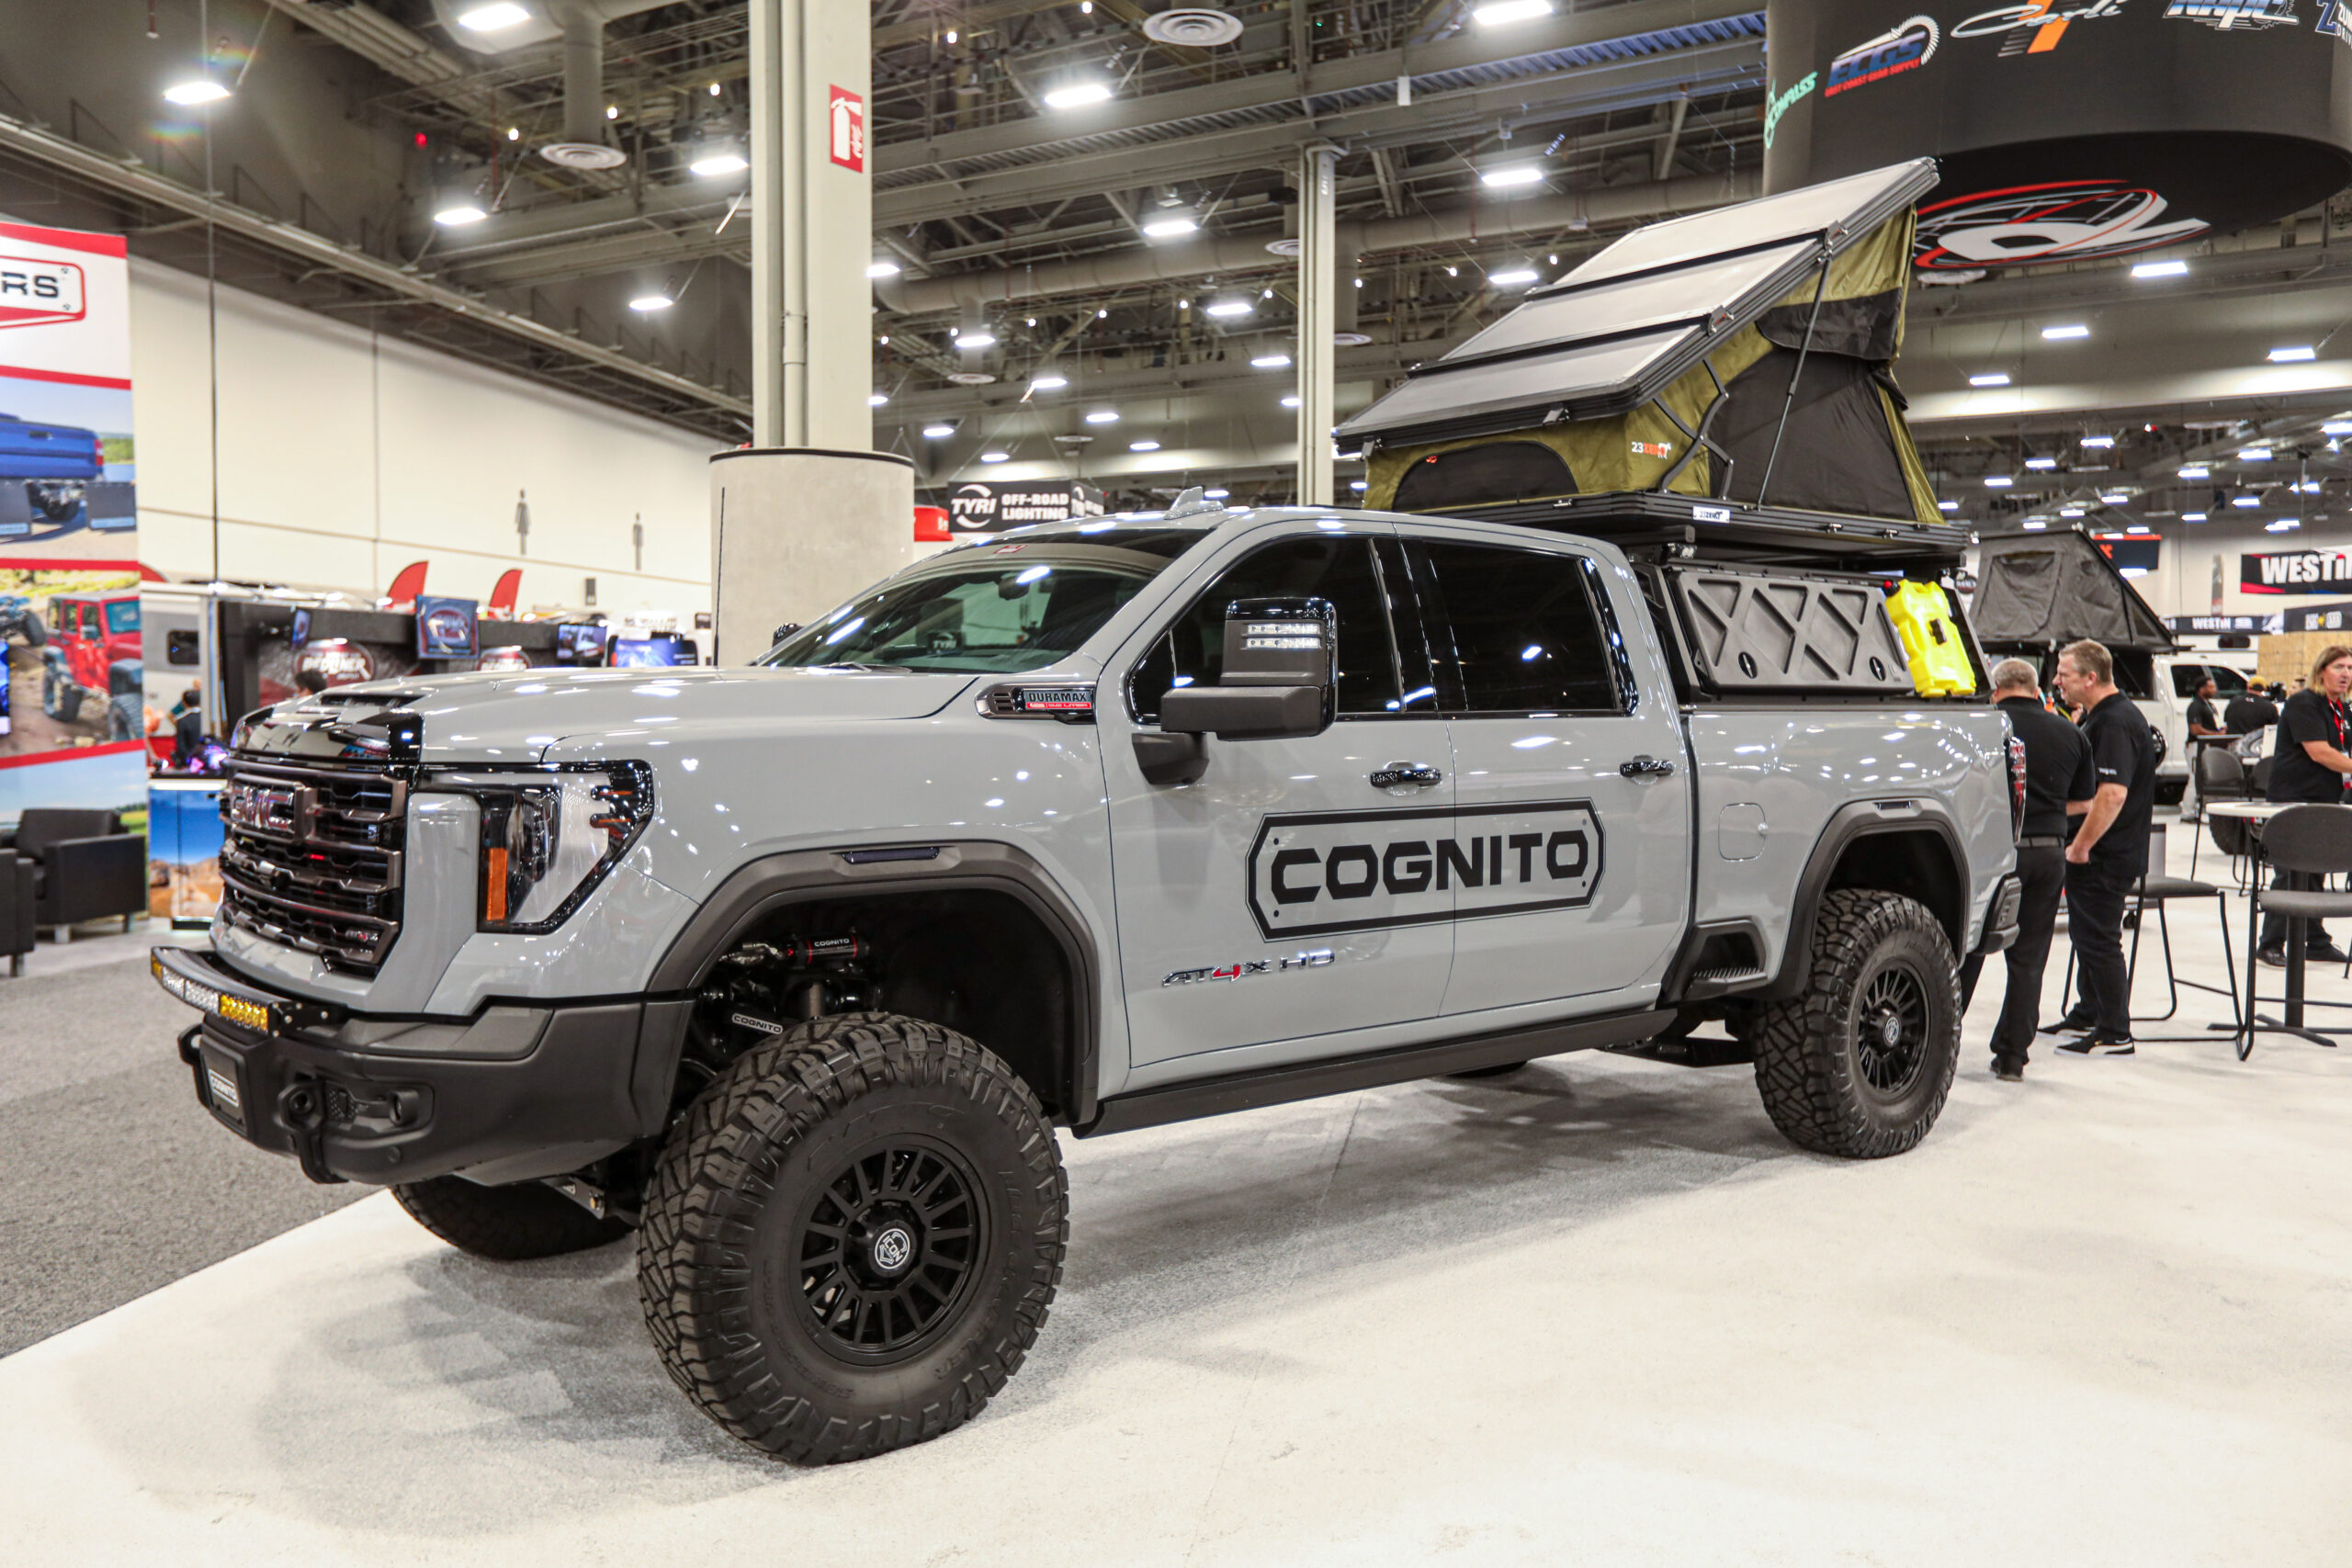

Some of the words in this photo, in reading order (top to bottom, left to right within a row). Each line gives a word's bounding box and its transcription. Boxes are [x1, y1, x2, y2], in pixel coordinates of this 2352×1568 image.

[1827, 31, 1926, 87] ECGS
[1842, 74, 1867, 90] COAST
[1889, 57, 1921, 74] SUPPLY
[951, 498, 997, 514] TYRI
[1001, 492, 1069, 505] OFF-ROAD
[1001, 507, 1069, 520] LIGHTING
[1029, 691, 1087, 702] DURAMAX
[229, 784, 295, 833] GMC
[1271, 829, 1589, 905] COGNITO
[814, 938, 850, 947] COGNITO
[1162, 959, 1272, 987] AT4X
[1280, 949, 1336, 972] HD
[733, 1014, 782, 1033] COGNITO
[882, 1235, 904, 1262] ICON
